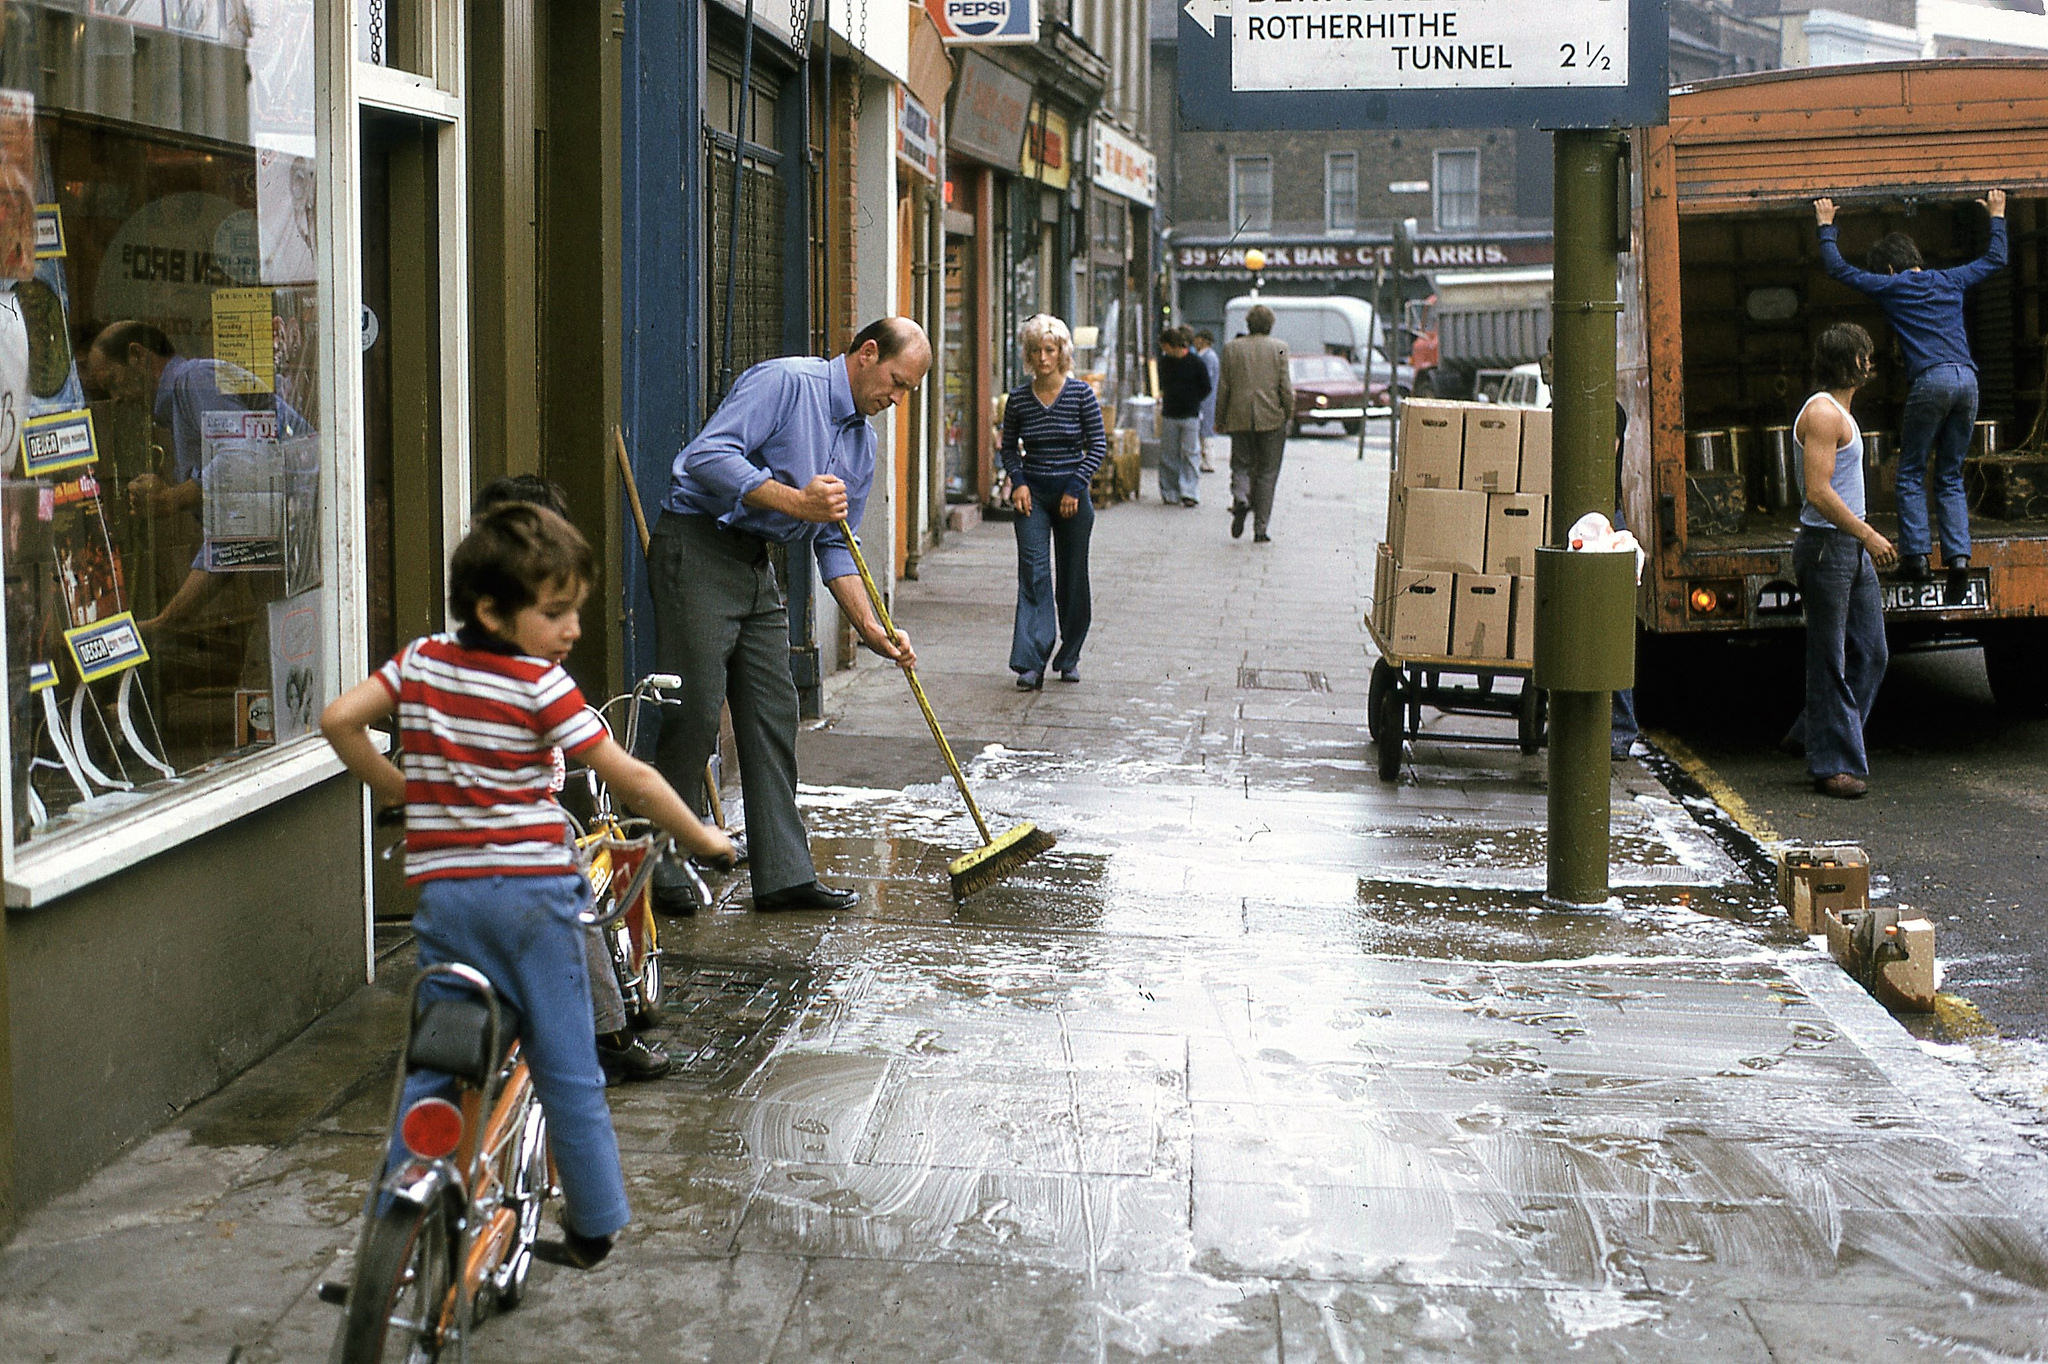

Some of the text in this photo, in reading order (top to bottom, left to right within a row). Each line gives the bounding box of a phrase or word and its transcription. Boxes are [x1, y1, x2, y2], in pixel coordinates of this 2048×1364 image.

[948, 1, 1006, 16] PEPSI
[1248, 13, 1458, 40] ROTHERHITHE
[1391, 44, 1512, 70] TUNNEL
[1218, 248, 1290, 266] SNCK
[1293, 248, 1339, 266] BAR
[29, 432, 59, 458] DECCA
[79, 638, 108, 663] DECCA
